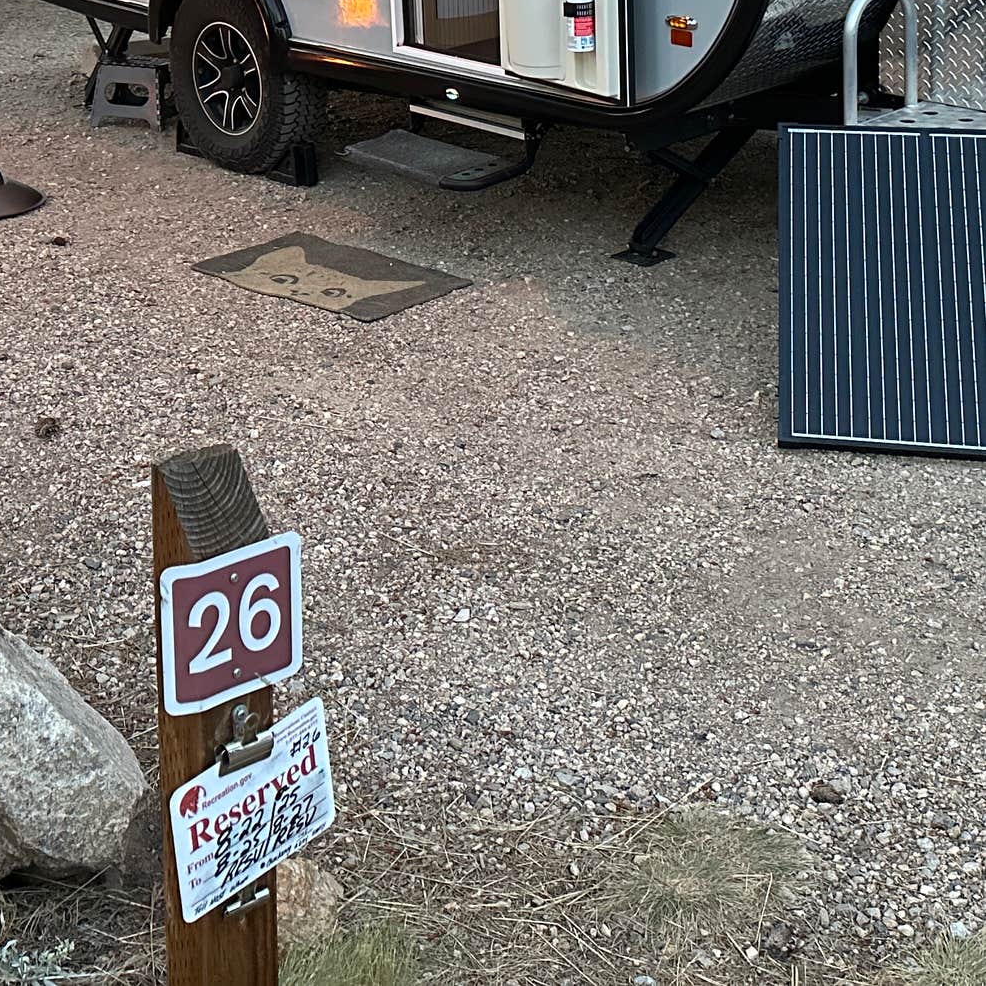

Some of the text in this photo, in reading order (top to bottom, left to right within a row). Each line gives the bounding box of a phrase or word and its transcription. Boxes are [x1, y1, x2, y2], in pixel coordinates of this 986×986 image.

[188, 572, 281, 674] 26
[188, 743, 318, 855] Reserved
[201, 772, 253, 810] Recreation.gov
[187, 852, 214, 875] From
[189, 877, 202, 890] To
